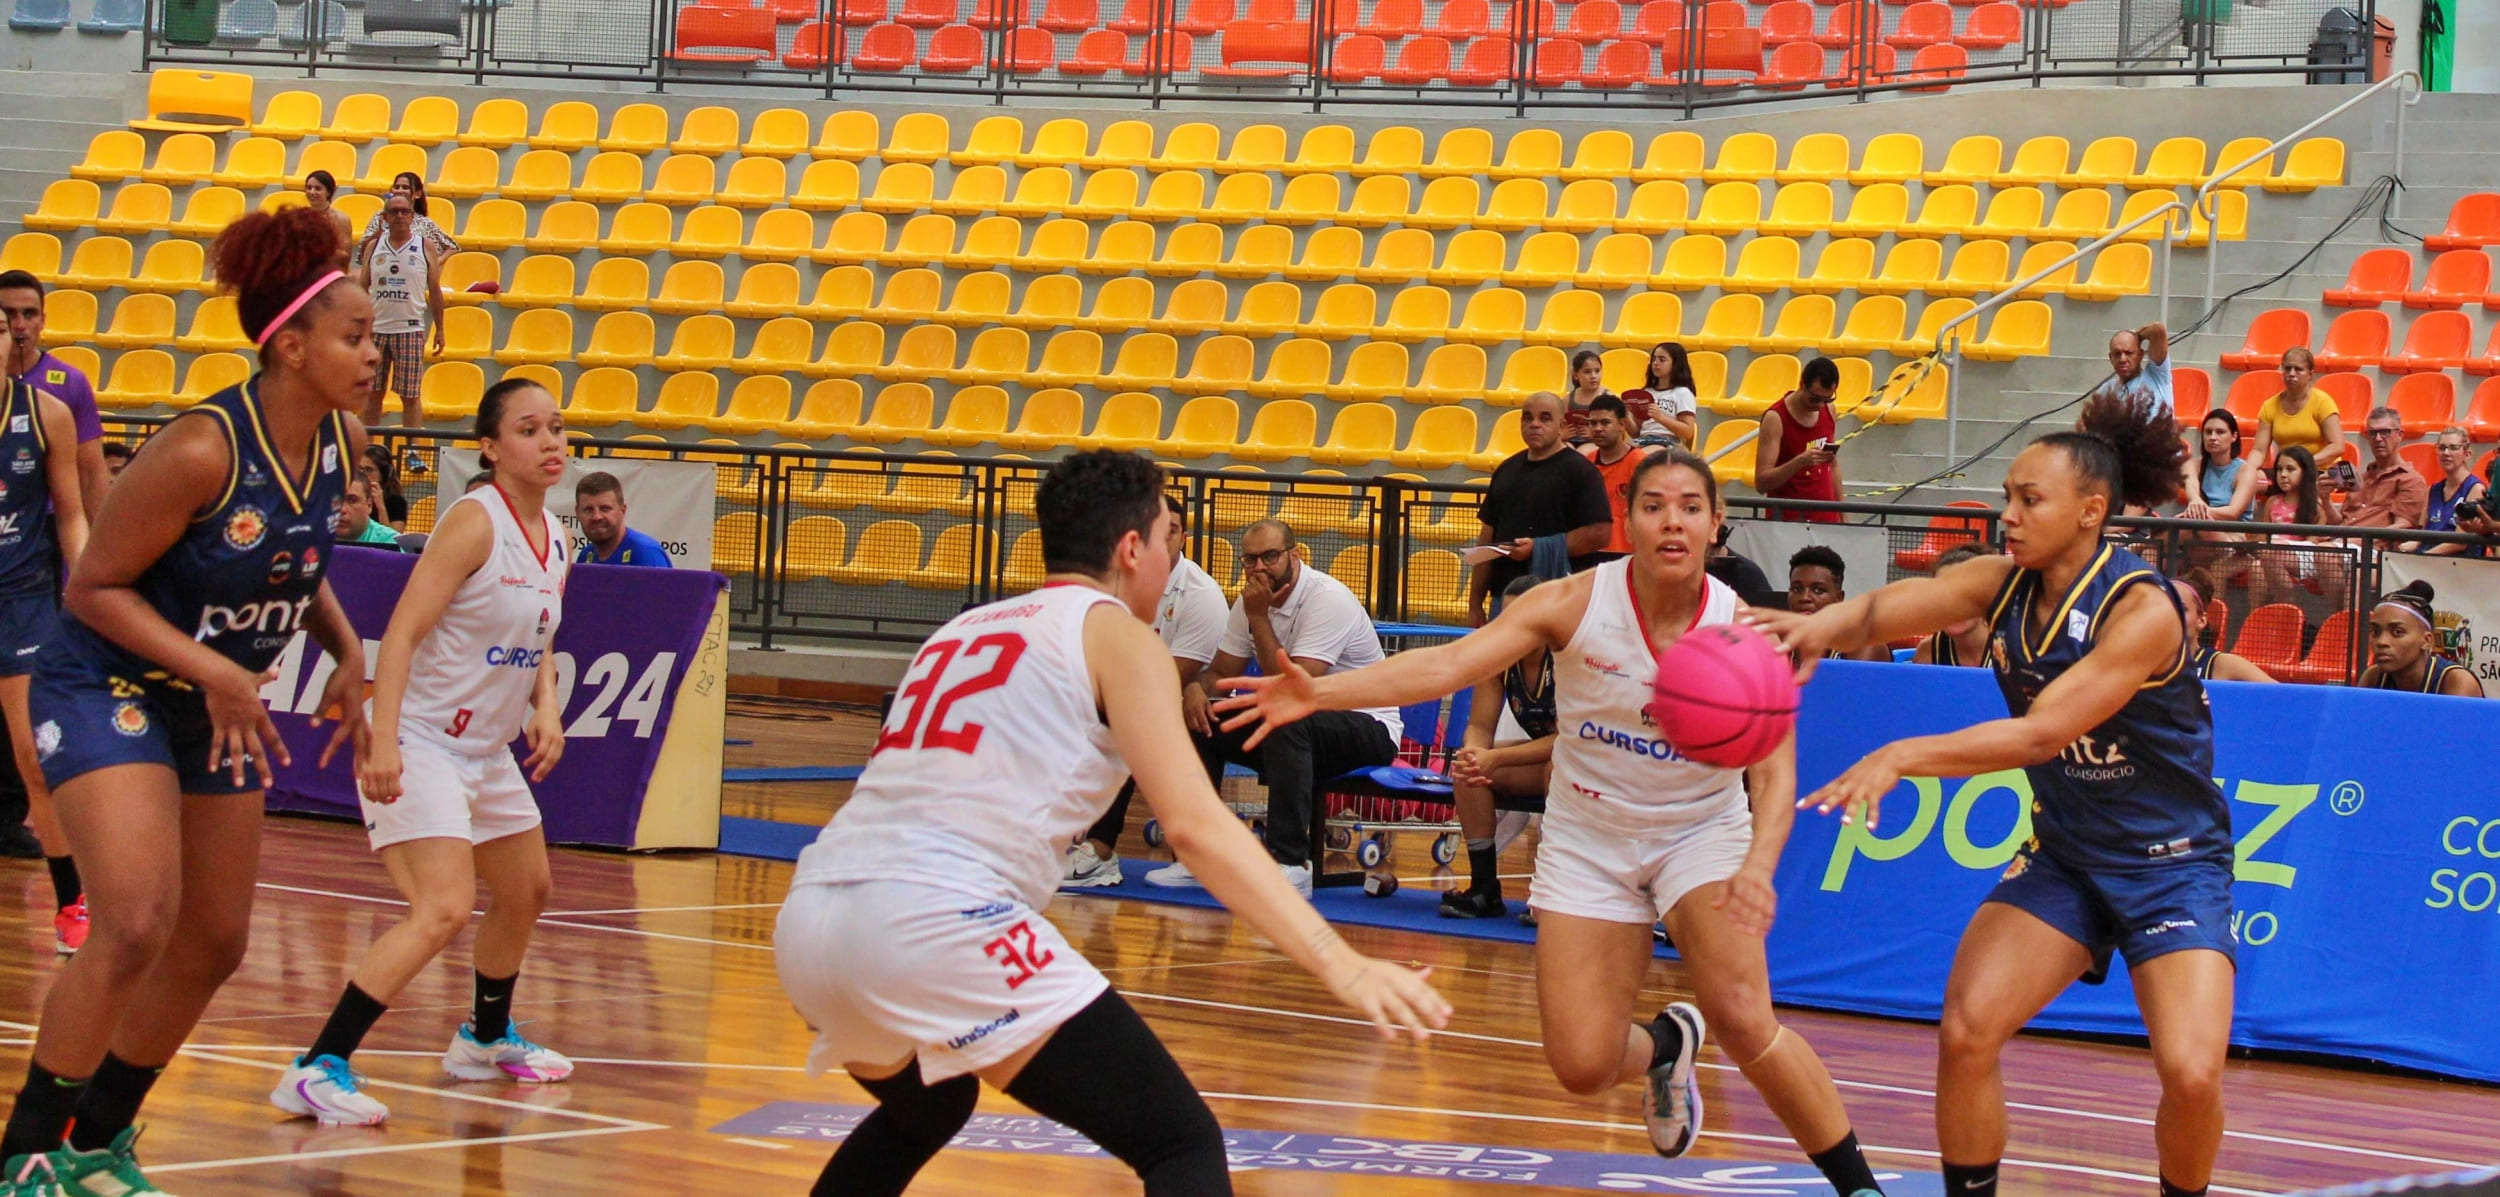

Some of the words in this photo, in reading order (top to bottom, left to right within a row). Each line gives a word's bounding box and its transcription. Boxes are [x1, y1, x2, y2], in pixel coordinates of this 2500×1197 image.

[661, 541, 687, 556] POS
[194, 596, 314, 643] pont
[2480, 635, 2500, 654] PR
[2480, 660, 2500, 680] SÃ
[521, 651, 677, 738] 024
[872, 632, 1027, 759] 32
[444, 708, 473, 738] 9
[1579, 721, 1694, 762] CURSO
[1820, 768, 2320, 892] poz
[2424, 868, 2500, 914] SO
[983, 920, 1055, 990] 32
[1317, 1137, 1553, 1165] CBC
